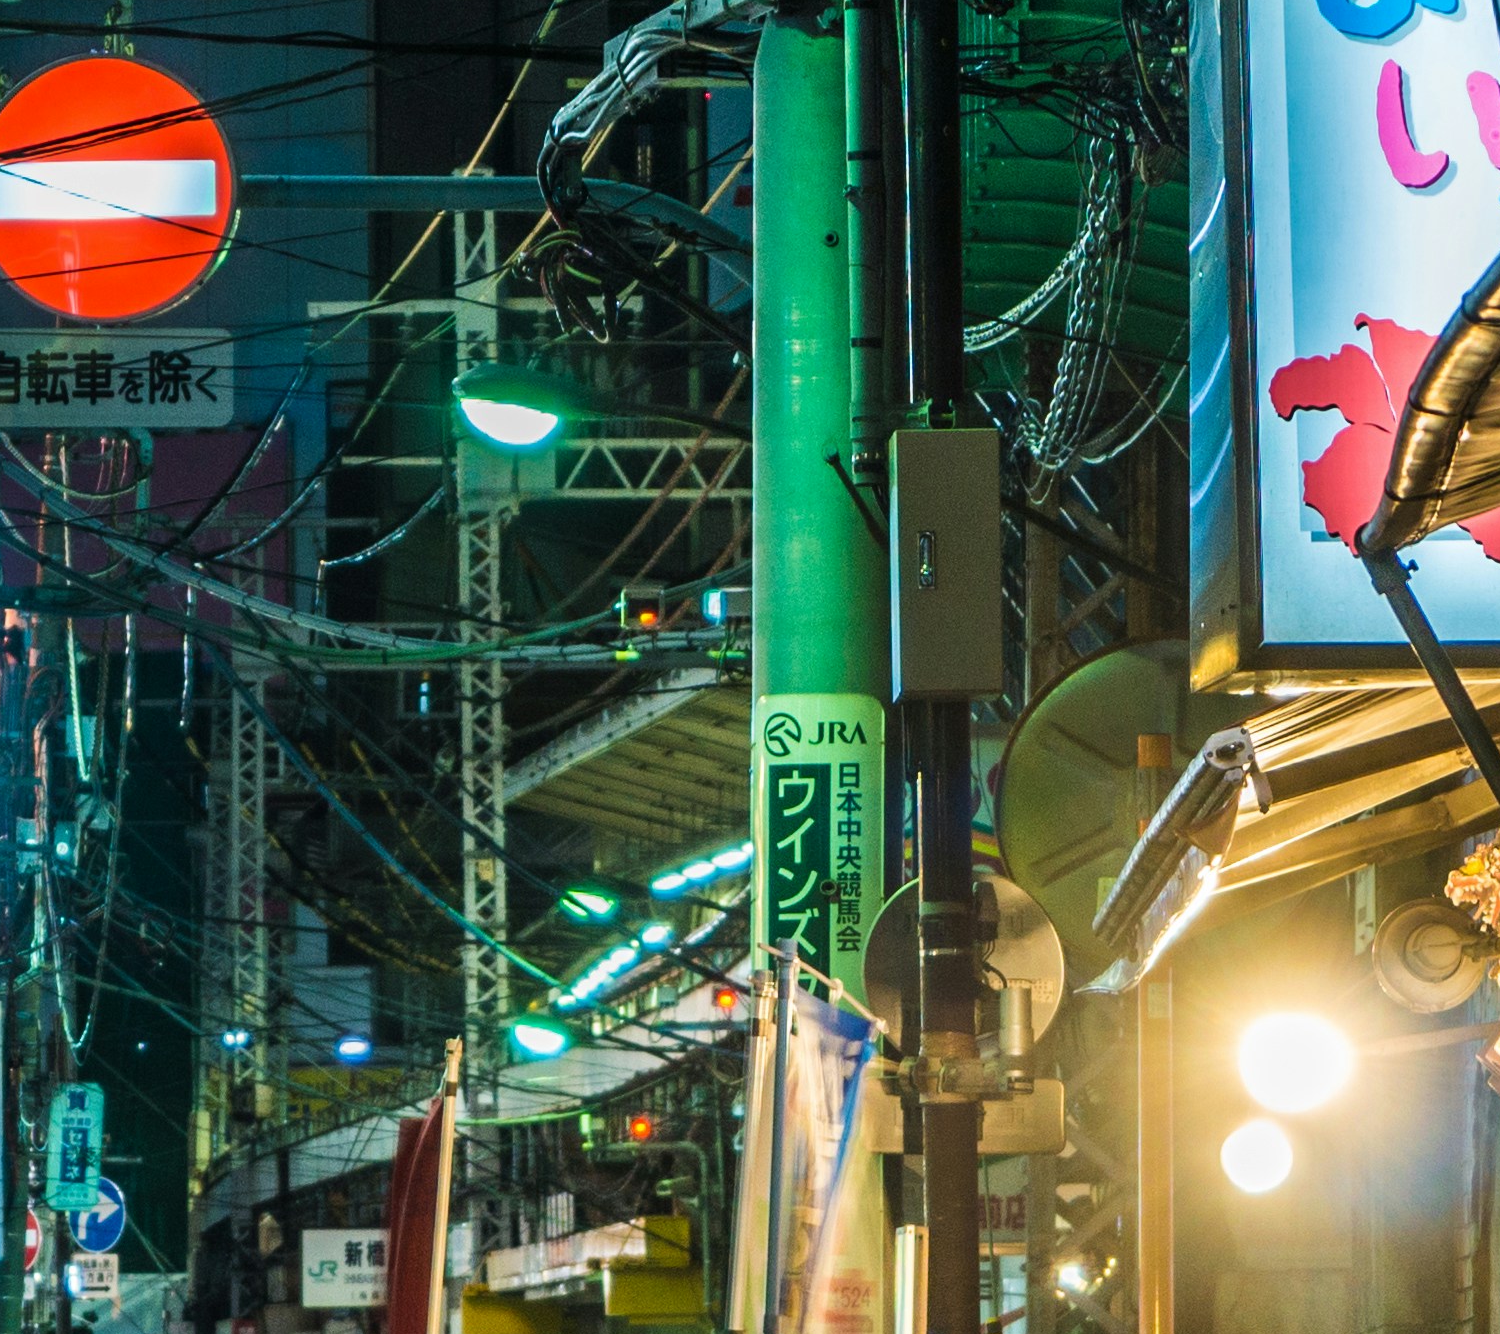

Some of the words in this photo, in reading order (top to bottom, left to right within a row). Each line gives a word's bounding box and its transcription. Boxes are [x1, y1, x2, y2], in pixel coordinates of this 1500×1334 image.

[808, 719, 868, 746] JRA
[836, 761, 862, 954] 日本中央競馬会
[344, 1238, 388, 1268] 新橋
[308, 1259, 339, 1278] JR
